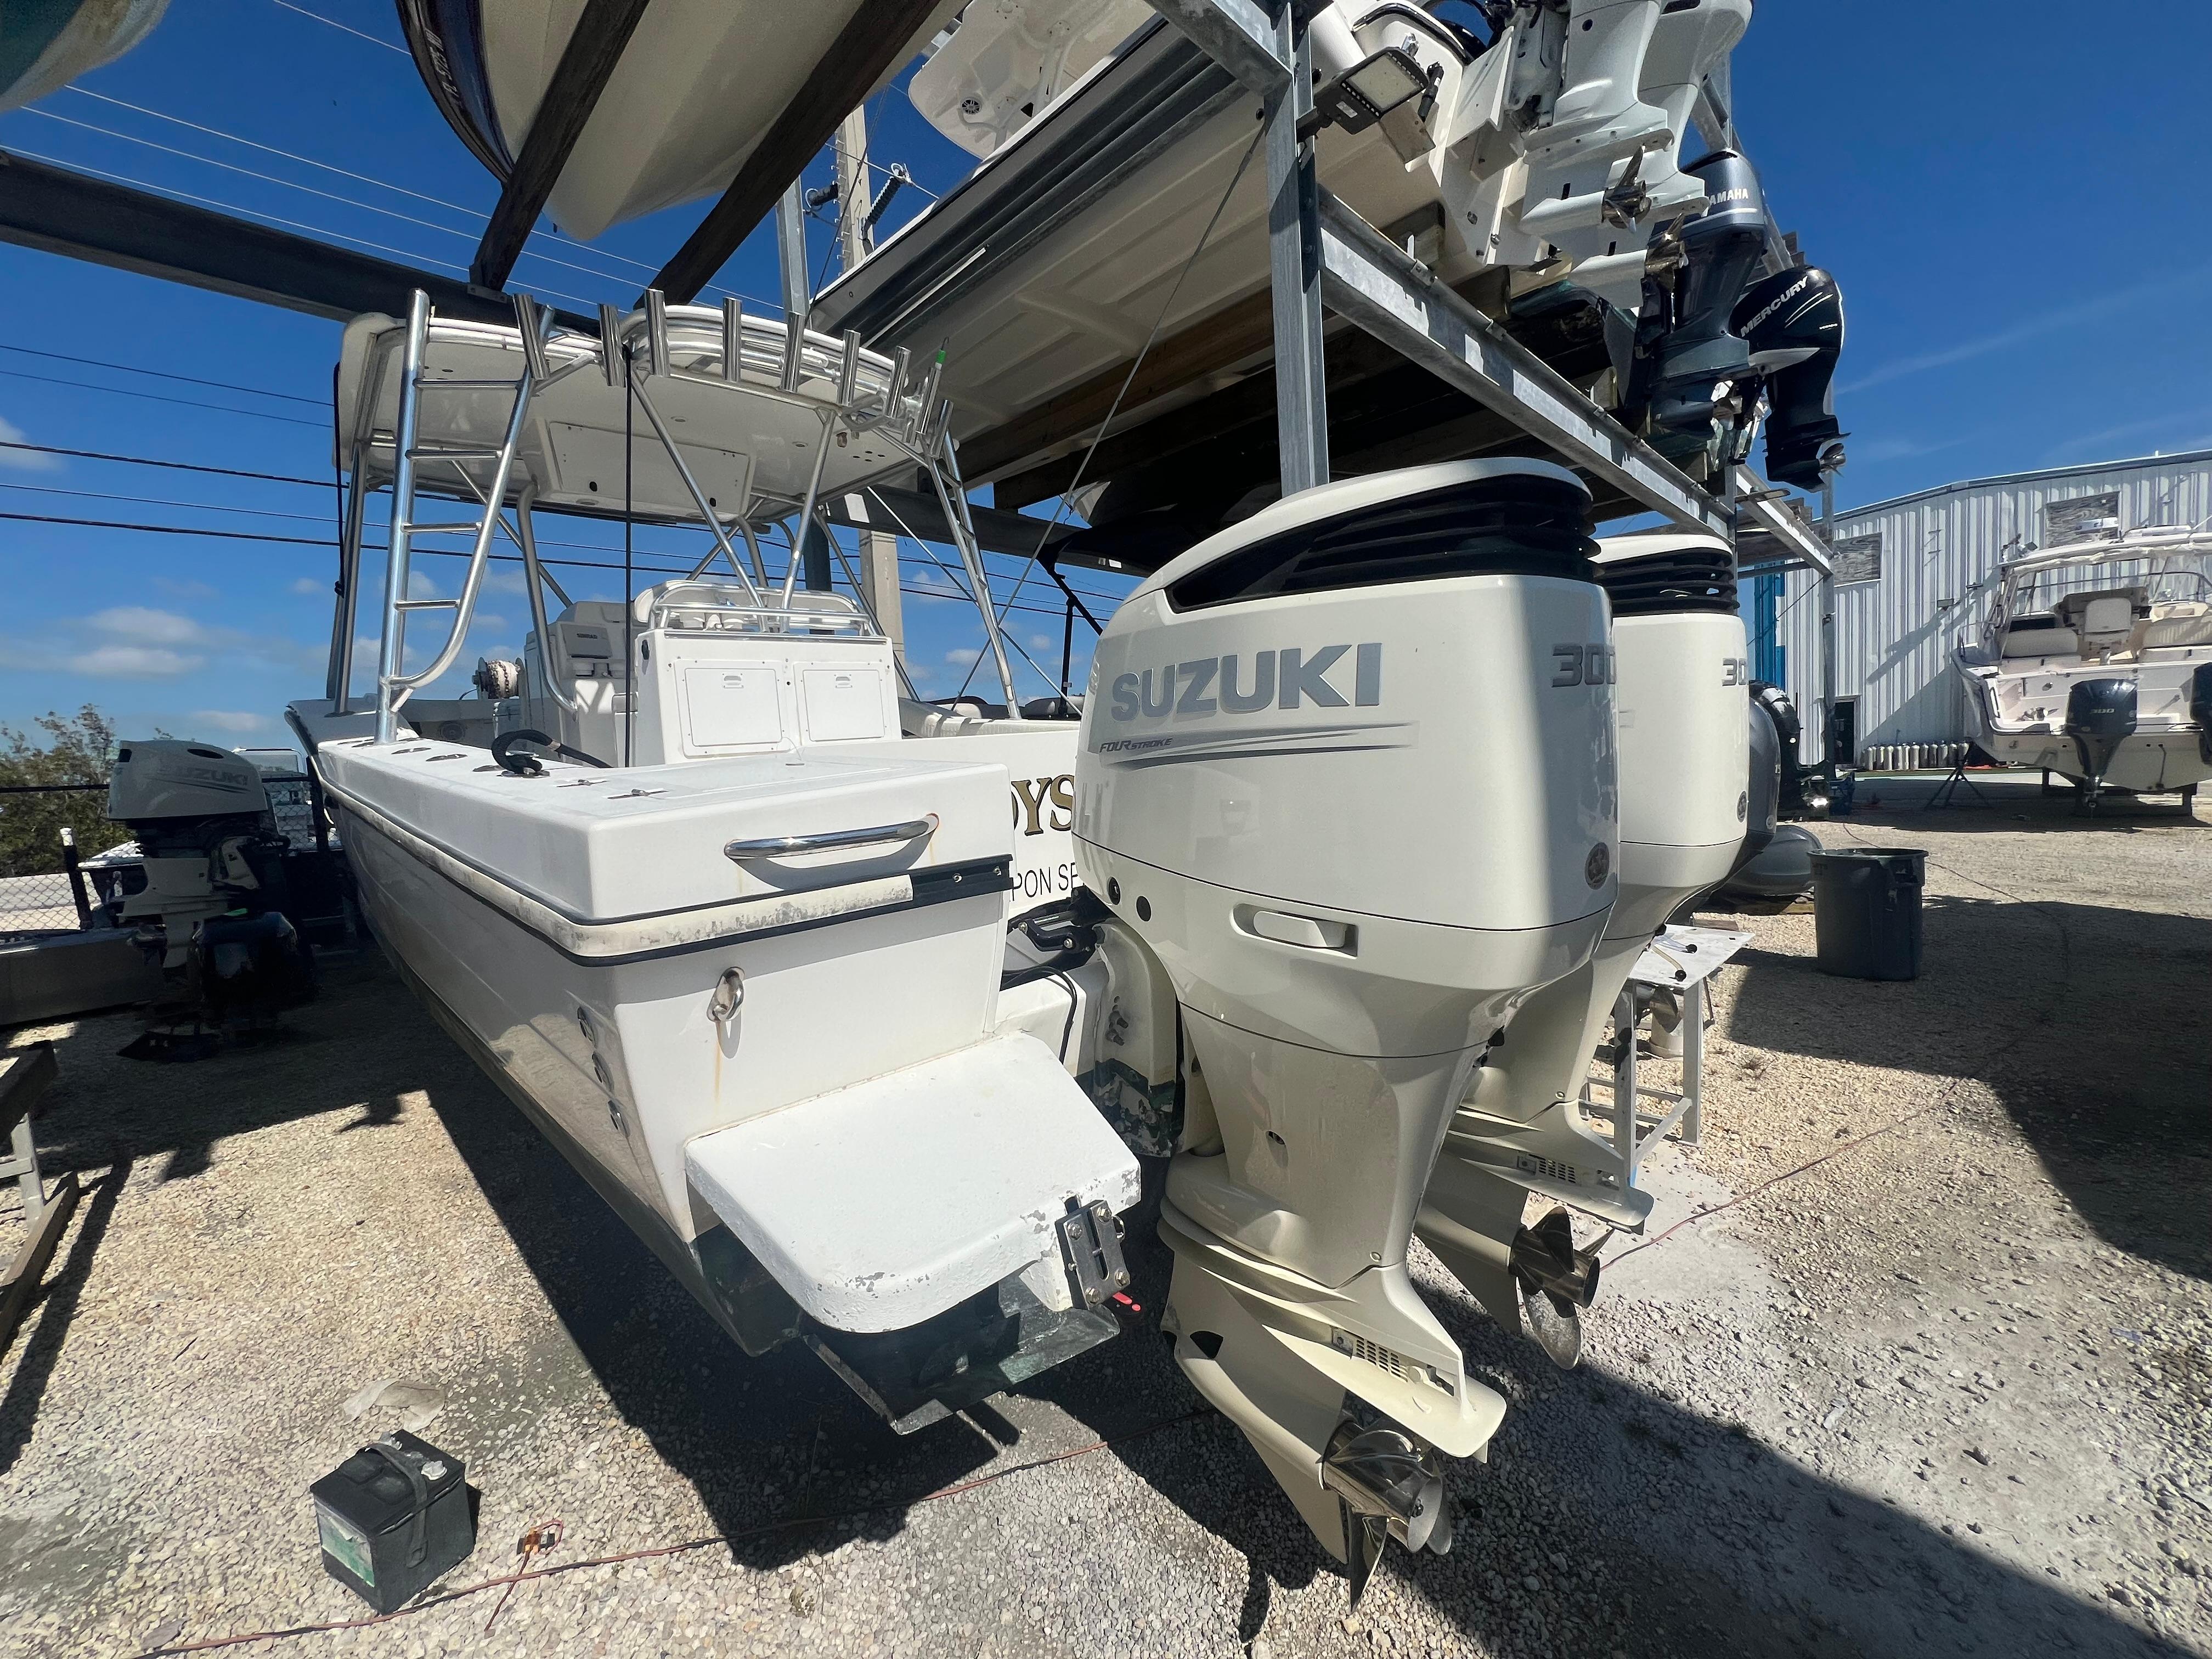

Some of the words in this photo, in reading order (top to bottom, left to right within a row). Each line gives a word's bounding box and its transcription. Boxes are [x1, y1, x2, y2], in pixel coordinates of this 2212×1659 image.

[1709, 188, 1749, 205] AMAHA
[1740, 275, 1808, 337] MERCURY
[1111, 642, 1383, 723] SUZUKI
[1011, 774, 1075, 837] YS
